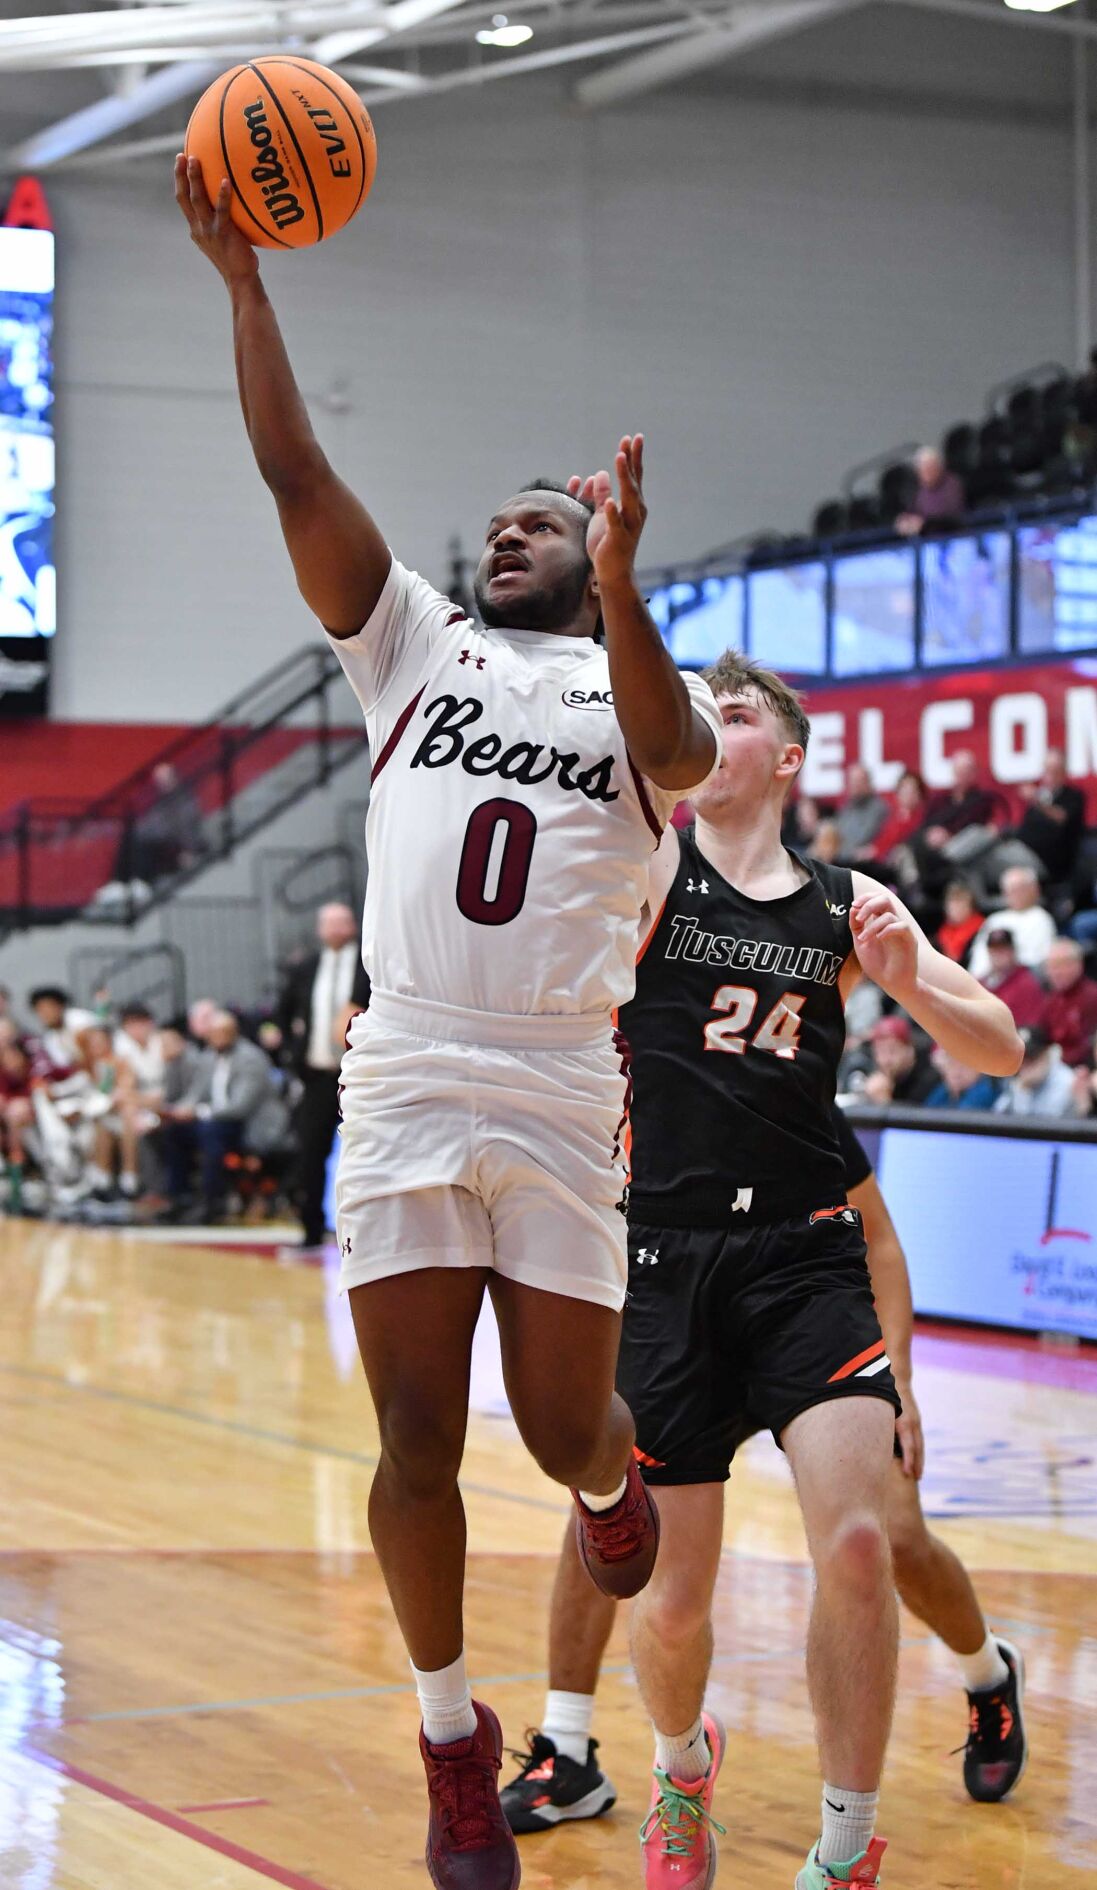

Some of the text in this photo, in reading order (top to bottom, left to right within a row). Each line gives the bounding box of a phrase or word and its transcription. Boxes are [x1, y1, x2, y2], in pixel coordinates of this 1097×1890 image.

[243, 100, 305, 230] Wilson
[307, 109, 351, 177] EVO
[410, 694, 620, 802] Bears
[456, 797, 537, 926] 0
[830, 903, 847, 916] AC
[665, 915, 843, 985] TUSCULUM
[704, 984, 807, 1060] 24
